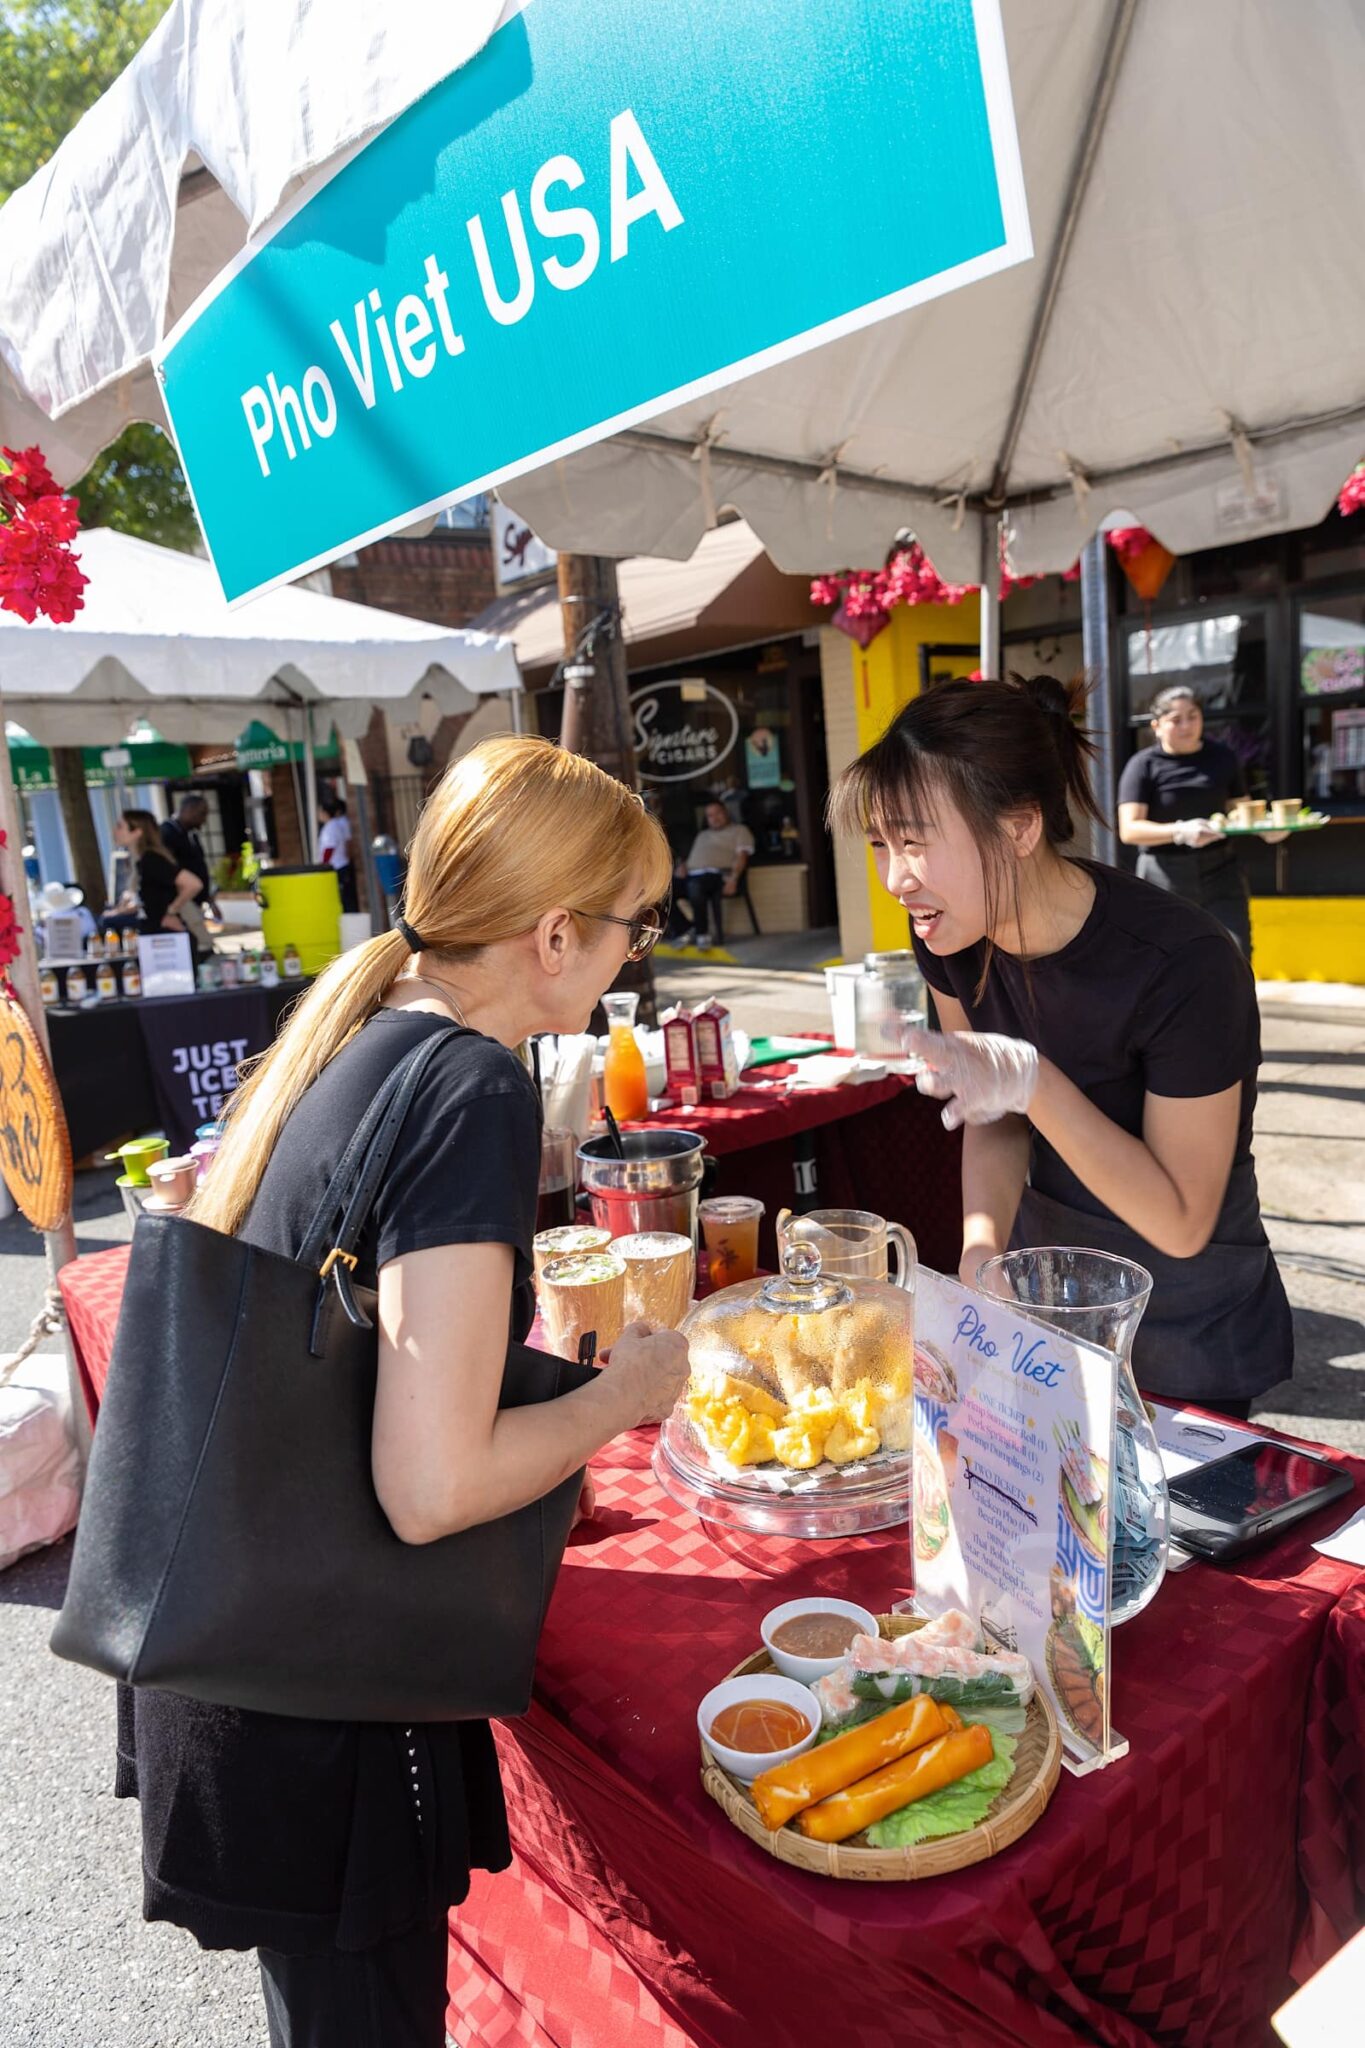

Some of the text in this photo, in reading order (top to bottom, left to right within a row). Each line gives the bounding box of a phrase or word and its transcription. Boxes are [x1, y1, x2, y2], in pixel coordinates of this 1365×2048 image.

[240, 107, 685, 477] Pho Viet USA
[634, 698, 719, 762] Signature
[656, 745, 717, 765] CIGARS
[172, 1039, 248, 1074] JUST
[188, 1065, 240, 1096] ICE
[191, 1093, 223, 1119] TE
[953, 1304, 999, 1357] Pho
[1012, 1331, 1065, 1387] Viet
[968, 1413, 985, 1432] Pork
[979, 1390, 1025, 1425] ONE TICKET
[1020, 1428, 1035, 1446] Roll
[974, 1460, 992, 1479] TWO
[994, 1473, 1026, 1503] TICKETS
[990, 1442, 1030, 1478] Dumplings
[1032, 1470, 1043, 1488] (2)
[972, 1488, 1001, 1517] Chicken
[1003, 1509, 1016, 1527] Pho
[977, 1505, 993, 1526] Beef
[995, 1518, 1009, 1536] Pho
[965, 1540, 979, 1558] Star
[1002, 1568, 1019, 1587] Iced
[1020, 1579, 1033, 1598] Tea
[1011, 1558, 1024, 1577] Tea
